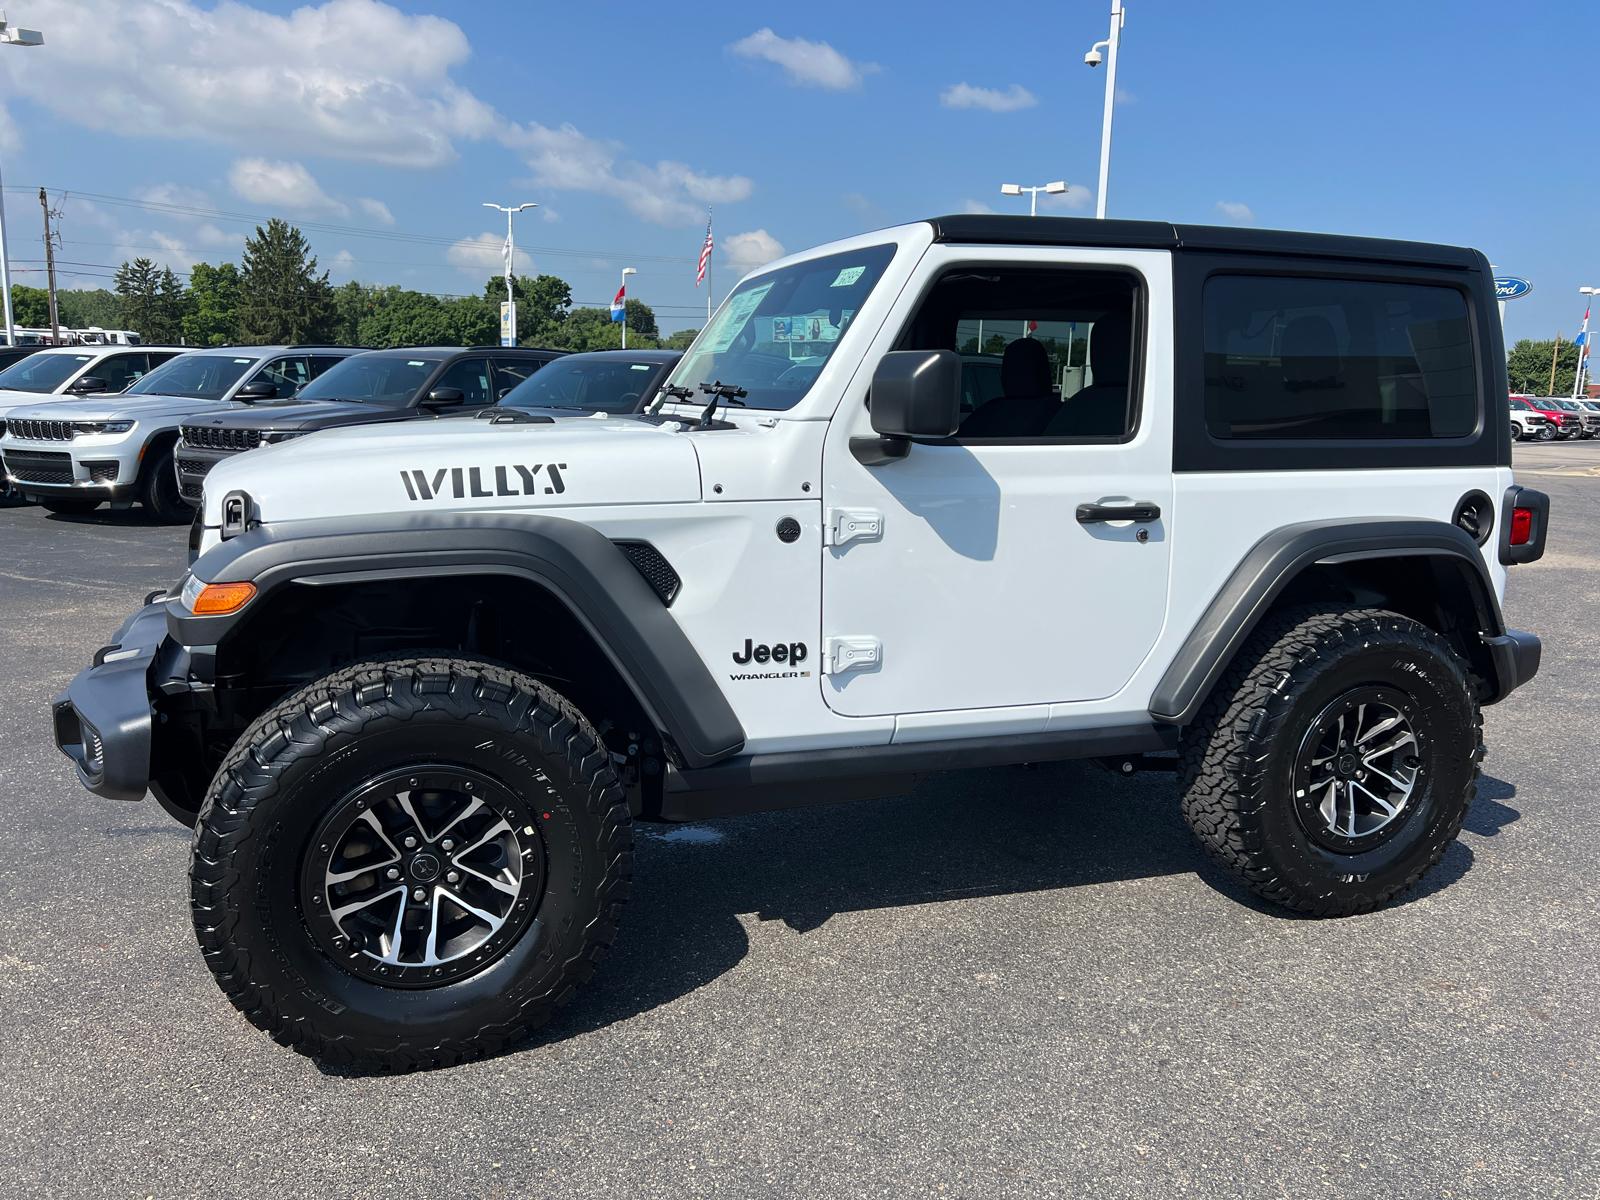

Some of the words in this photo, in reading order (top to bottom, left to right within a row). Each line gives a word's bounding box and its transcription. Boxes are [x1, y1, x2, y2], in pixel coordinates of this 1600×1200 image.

[399, 462, 568, 501] WILLYS
[732, 638, 808, 666] Jeep
[729, 671, 799, 681] WRANGLER
